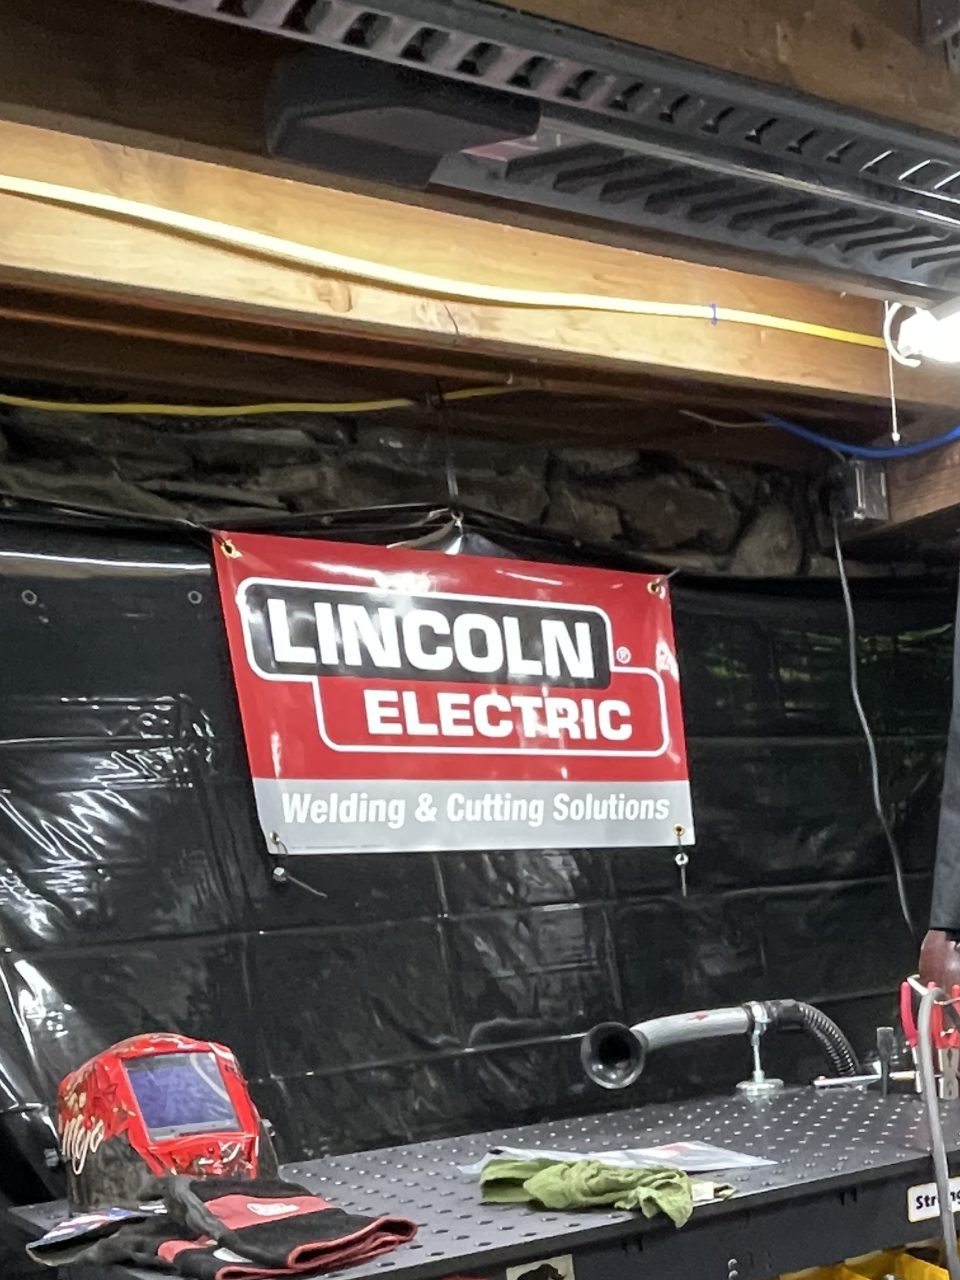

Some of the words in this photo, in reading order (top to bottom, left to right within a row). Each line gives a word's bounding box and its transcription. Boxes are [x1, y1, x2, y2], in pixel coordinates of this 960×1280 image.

[266, 598, 596, 680] LINCOLN
[363, 688, 633, 741] ELECTRIC
[282, 793, 404, 829] Welding
[414, 796, 438, 823] &
[447, 795, 543, 827] Cutting
[553, 793, 671, 821] Solutions
